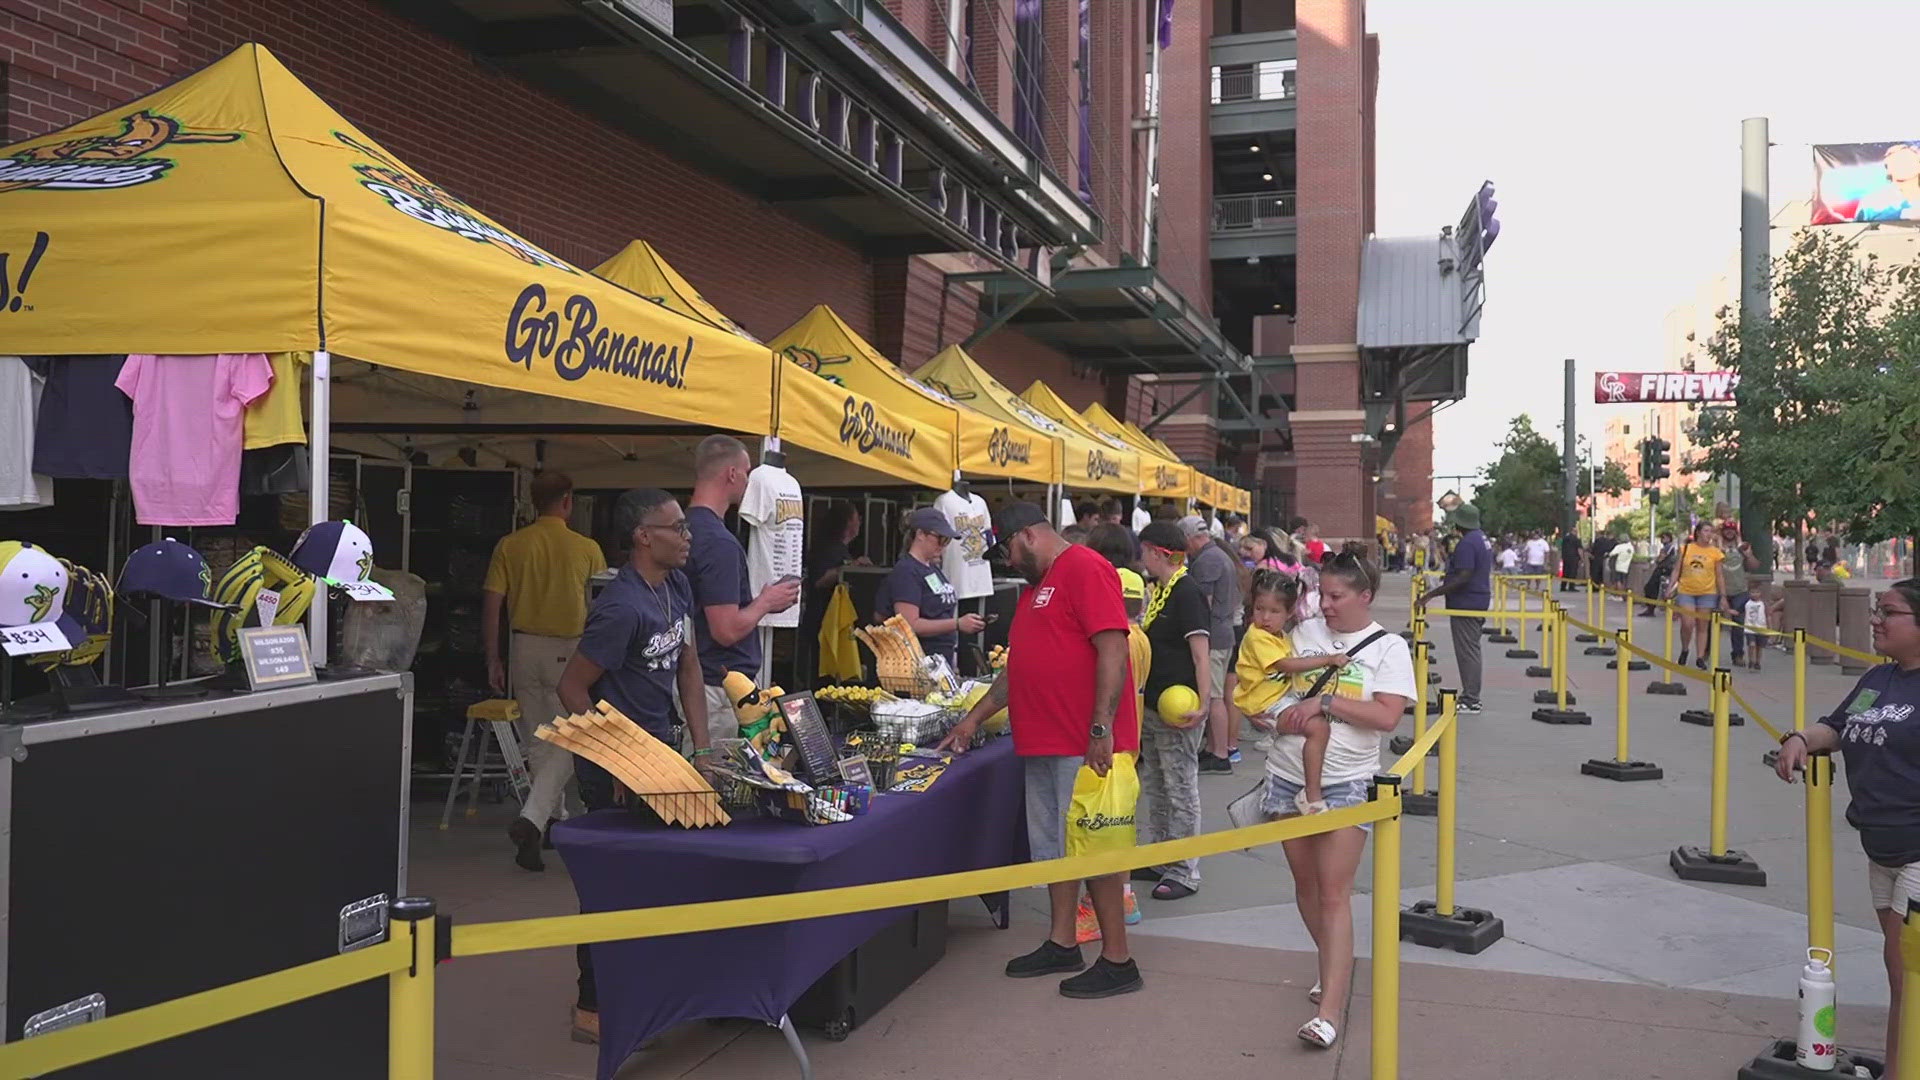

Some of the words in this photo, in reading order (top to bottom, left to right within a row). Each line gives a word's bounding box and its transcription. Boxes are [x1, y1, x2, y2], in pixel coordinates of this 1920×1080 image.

[732, 17, 904, 186] TICKET
[933, 166, 1019, 262] SALES
[505, 283, 559, 371] Go
[554, 294, 694, 390] Bananas!
[840, 395, 863, 448] Go
[858, 401, 916, 459] Bananas!
[257, 592, 279, 605] A450
[9, 628, 54, 645] $34
[254, 638, 279, 646] WILSON
[258, 657, 283, 666] WILSON
